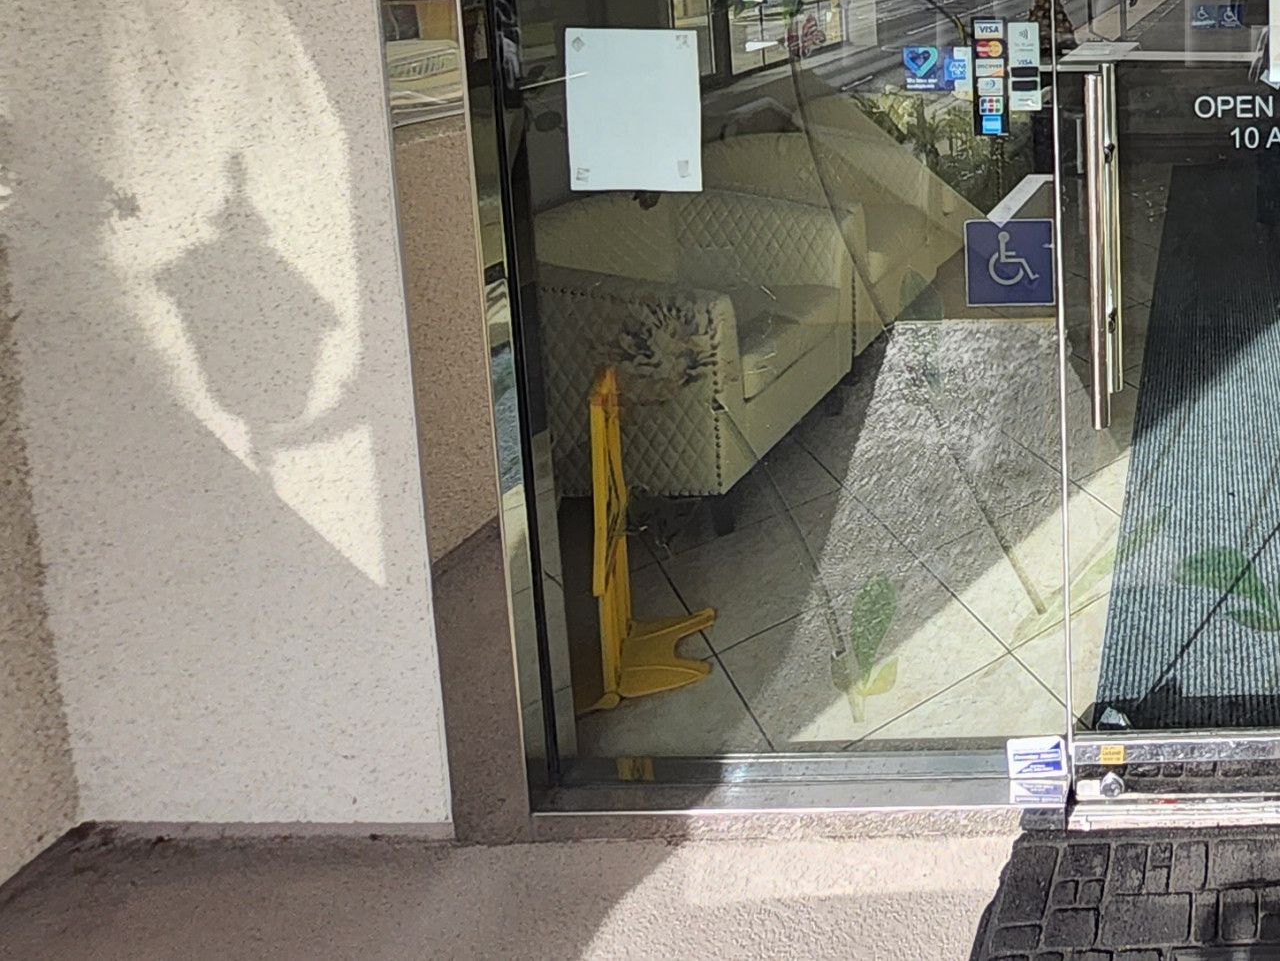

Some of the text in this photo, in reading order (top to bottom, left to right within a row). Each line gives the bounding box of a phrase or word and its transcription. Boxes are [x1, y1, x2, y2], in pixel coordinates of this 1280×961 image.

[979, 25, 1000, 34] VISA
[1194, 96, 1274, 118] OPEN
[1230, 127, 1260, 148] 10
